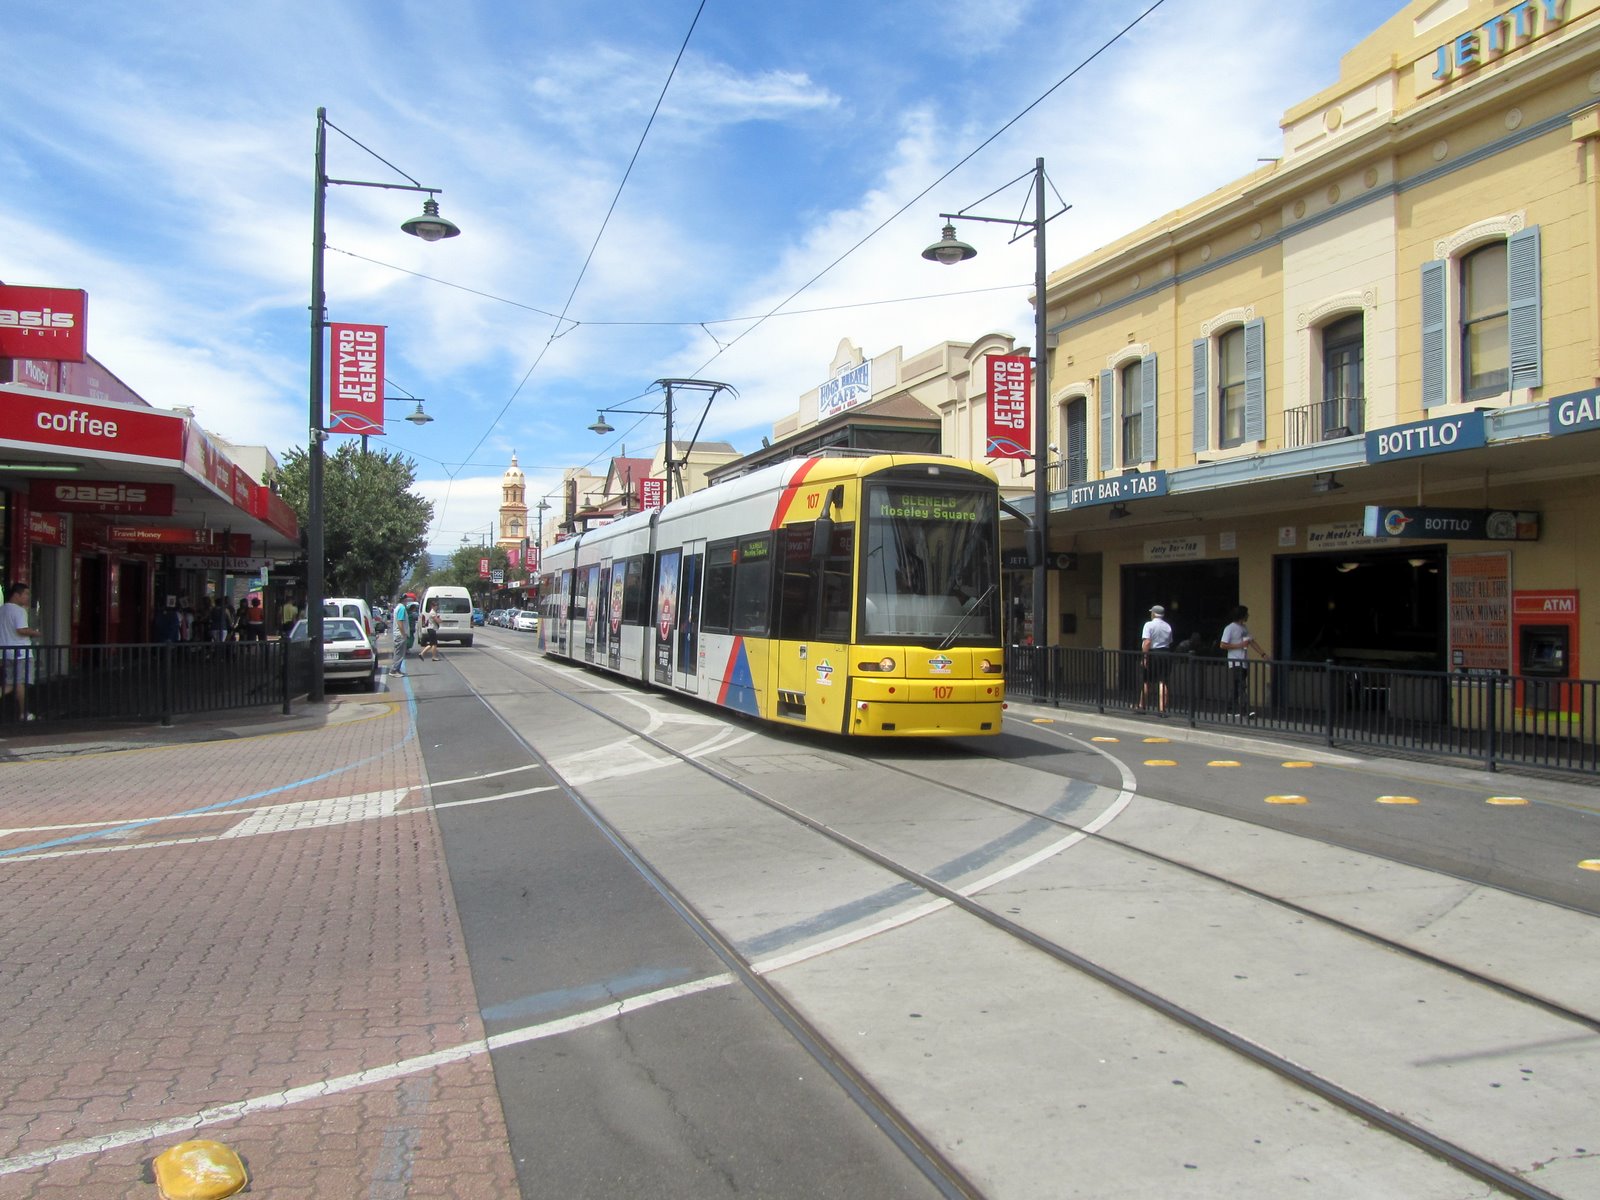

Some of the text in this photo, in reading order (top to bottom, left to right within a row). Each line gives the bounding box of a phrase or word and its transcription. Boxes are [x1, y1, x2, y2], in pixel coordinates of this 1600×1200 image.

[23, 328, 69, 338] deli
[356, 331, 377, 403] GLENELG
[831, 386, 856, 408] CAFE
[1007, 362, 1025, 429] GLENELG
[37, 410, 118, 438] coffee
[1379, 420, 1463, 455] BOTTLO'
[55, 485, 147, 502] oasis
[1070, 475, 1157, 505] JETTY BAR TAB
[806, 493, 820, 509] 107
[902, 495, 957, 507] GLENELG
[880, 504, 976, 521] Moseley Square
[113, 529, 161, 540] Travel Money
[201, 558, 249, 570] Spakles
[1009, 557, 1027, 565] JETT
[1543, 599, 1572, 611] ATM
[932, 686, 954, 700] 107
